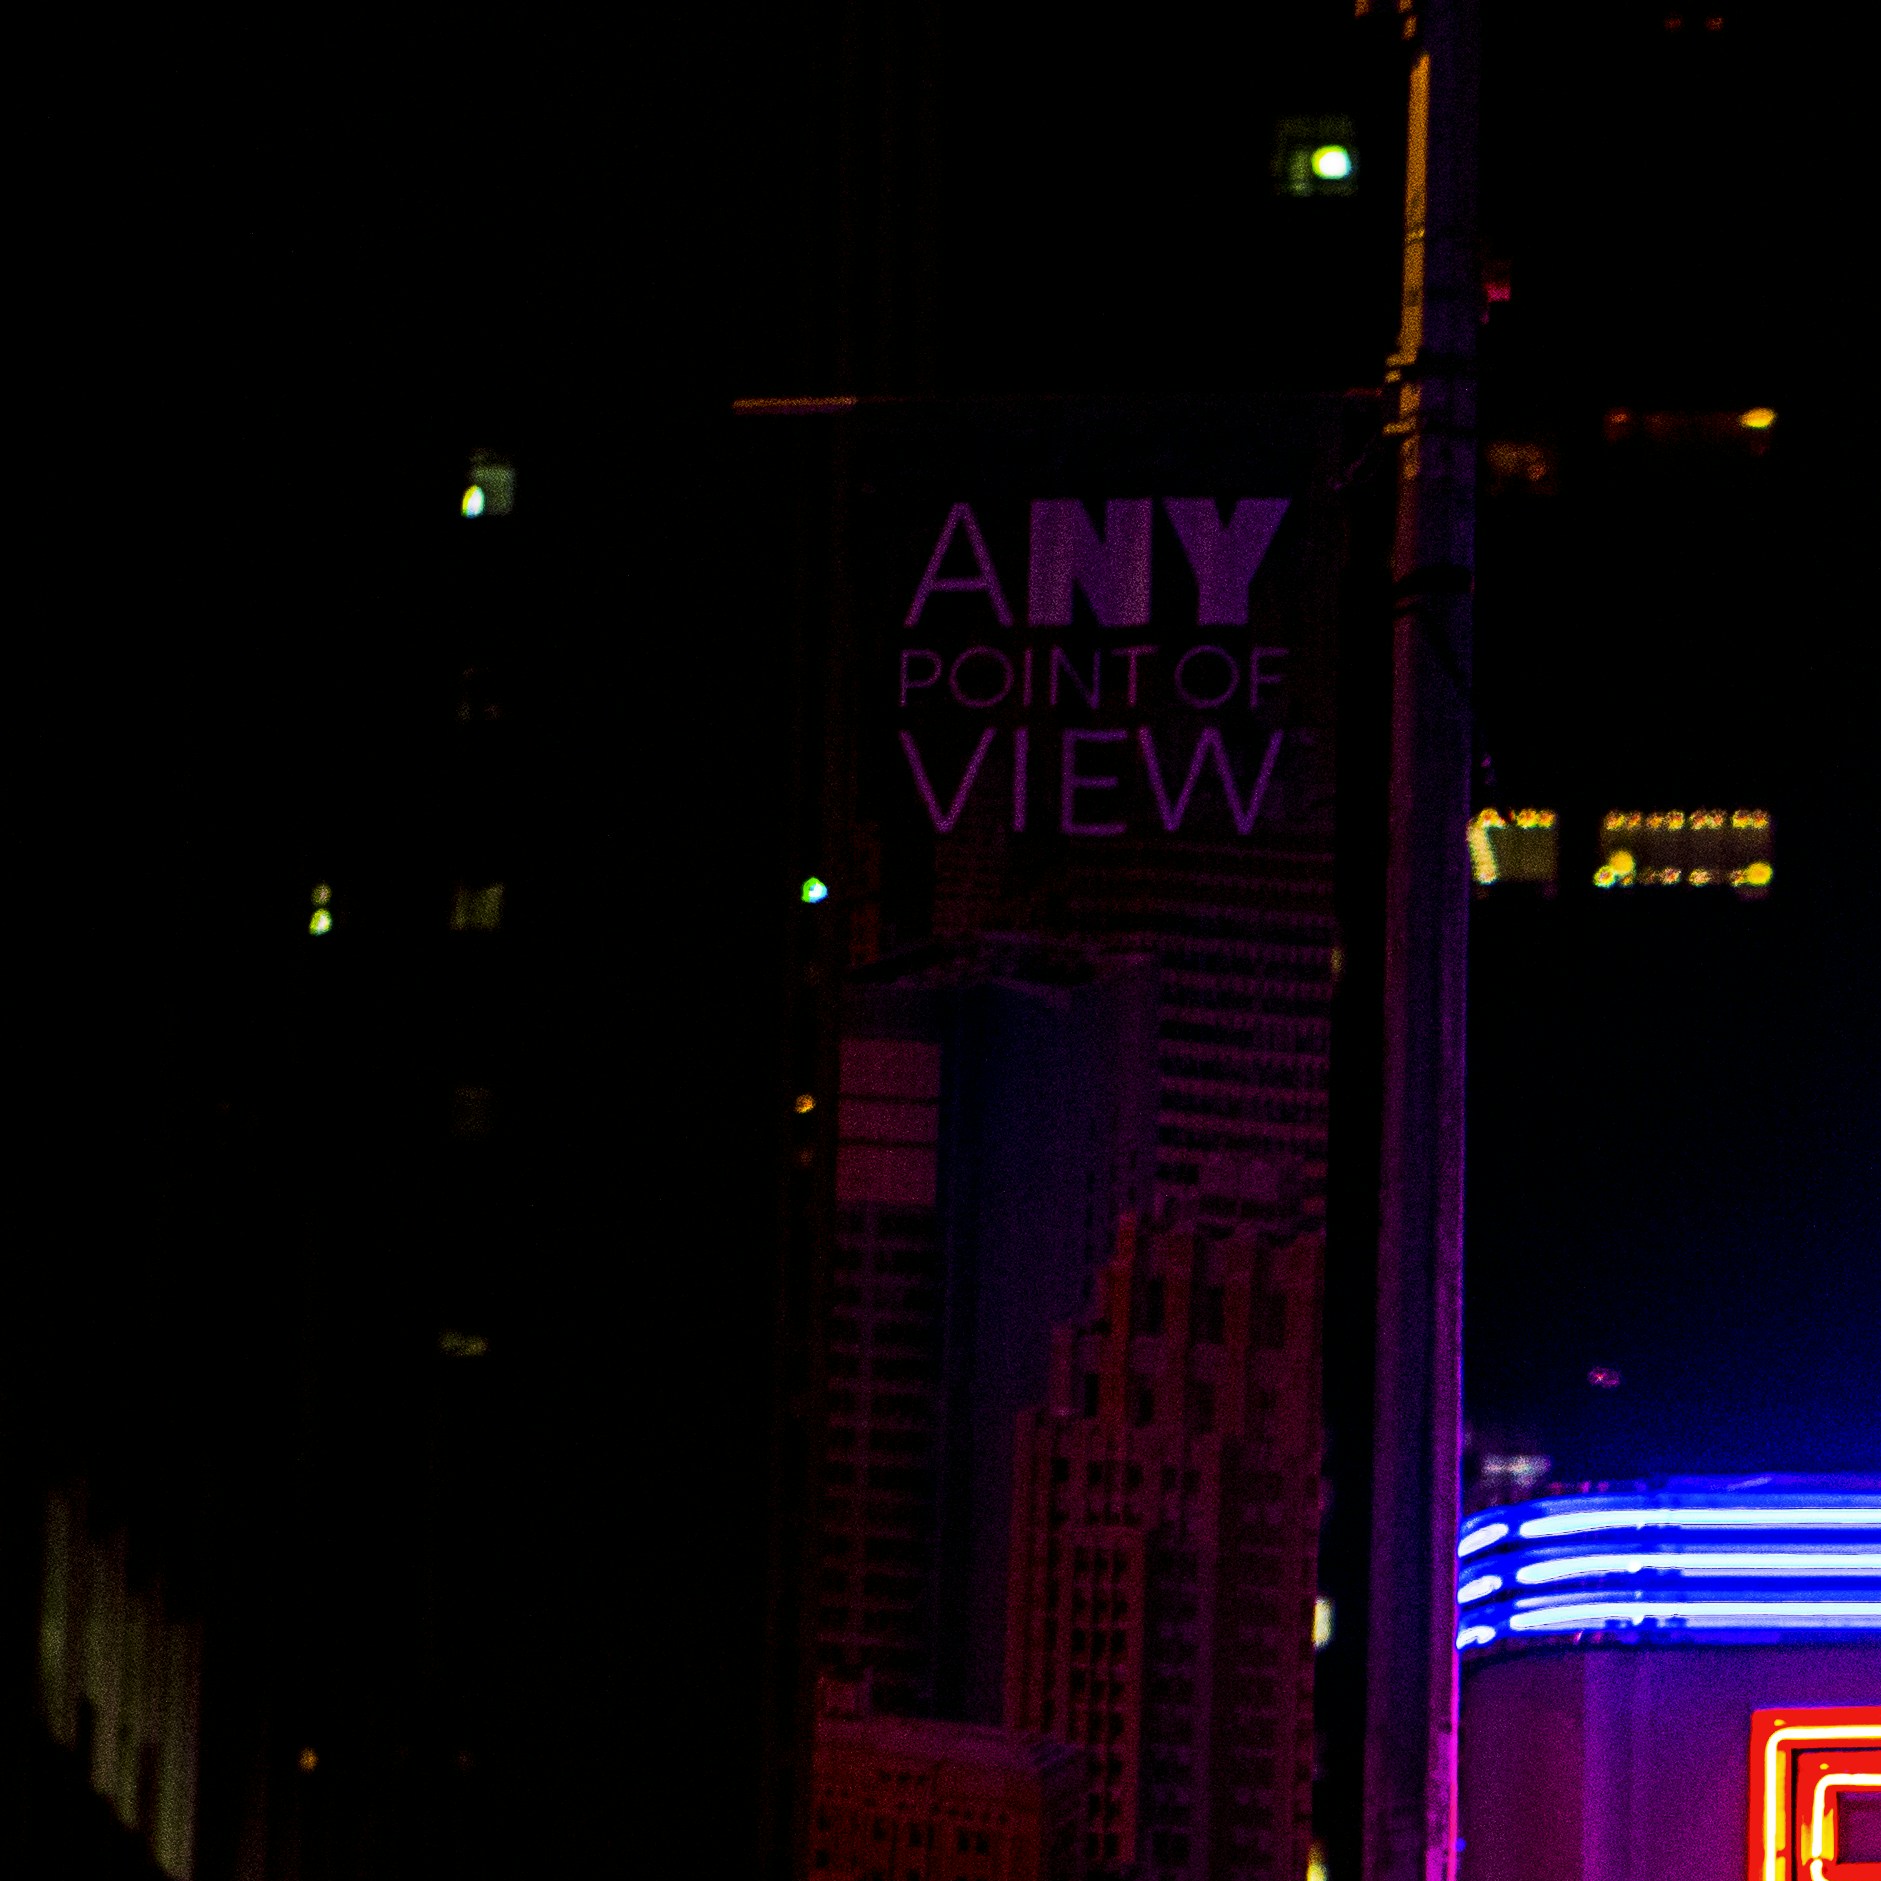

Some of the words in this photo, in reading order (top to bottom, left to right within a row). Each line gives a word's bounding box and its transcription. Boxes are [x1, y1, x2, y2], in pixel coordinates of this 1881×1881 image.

[903, 497, 1292, 630] ANY
[899, 643, 1163, 710] POINT
[1172, 643, 1292, 710] OF
[899, 724, 1286, 837] VIEW
